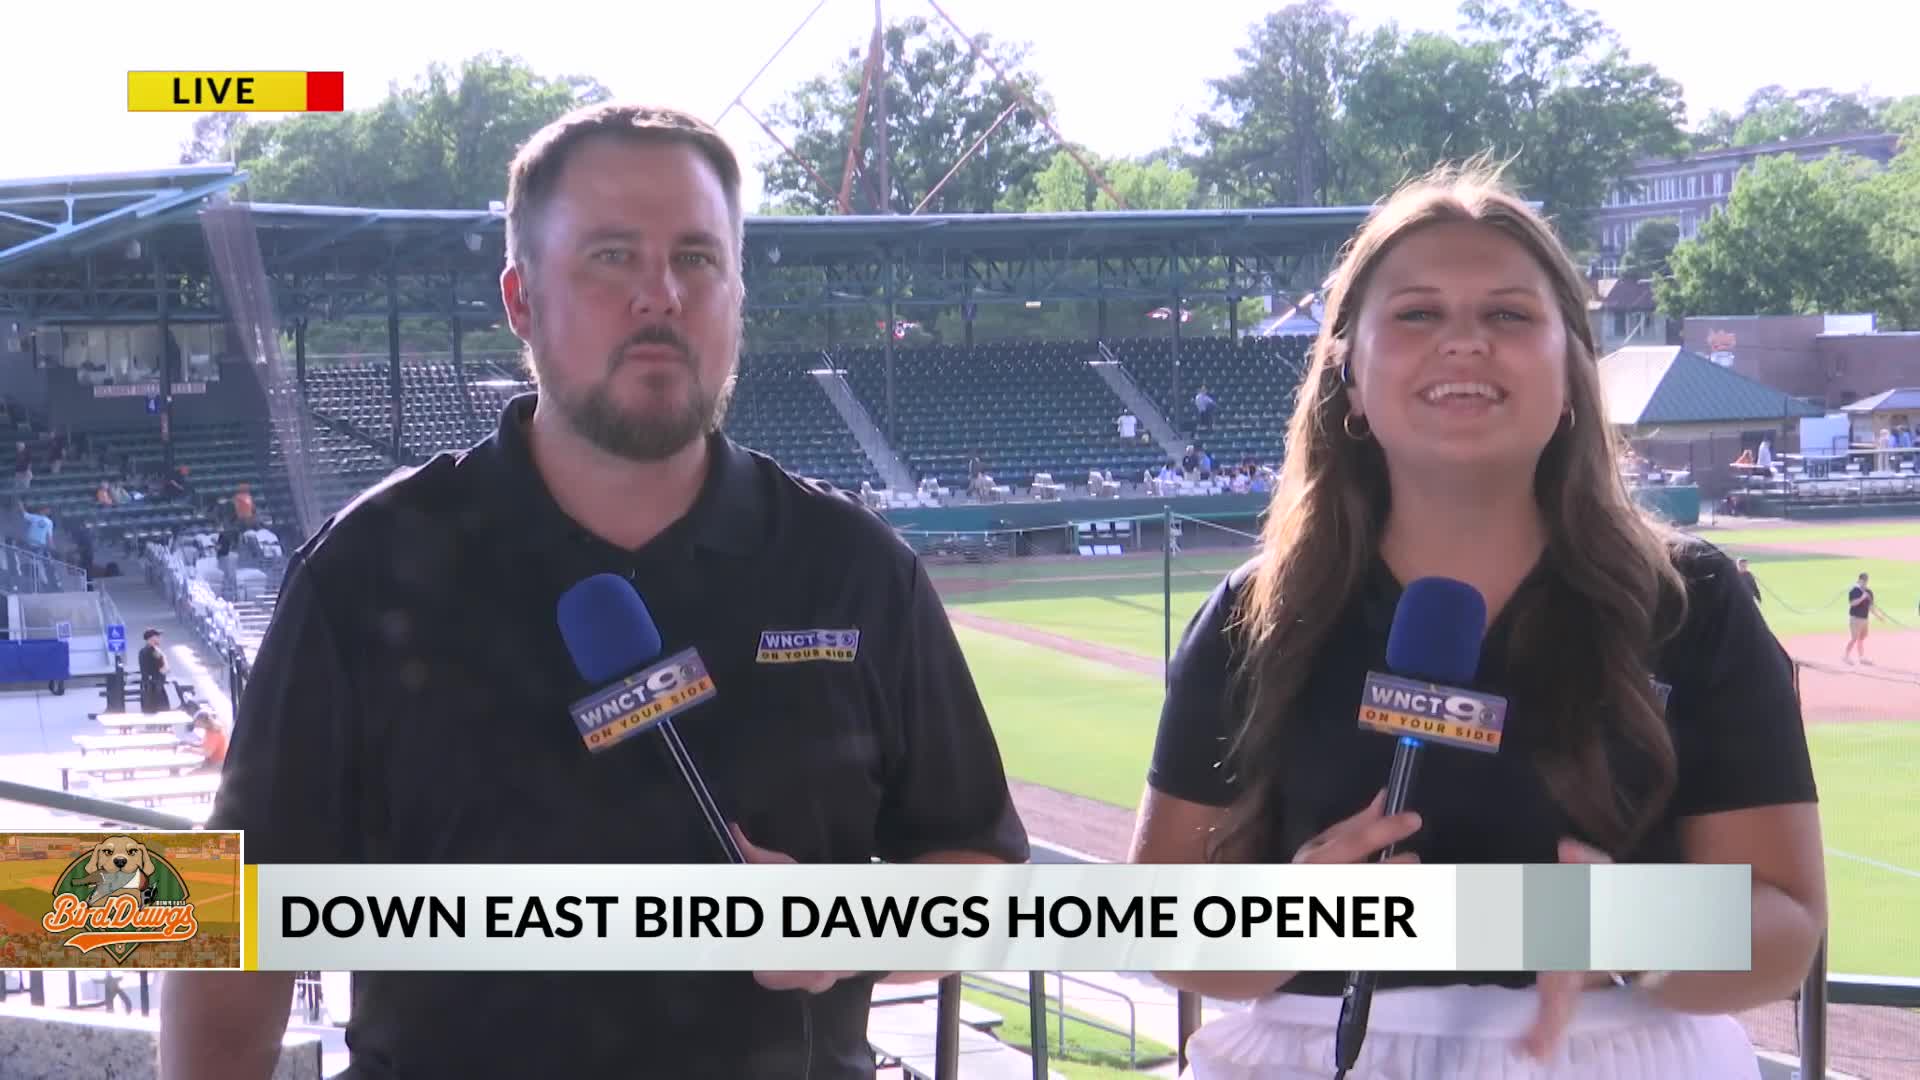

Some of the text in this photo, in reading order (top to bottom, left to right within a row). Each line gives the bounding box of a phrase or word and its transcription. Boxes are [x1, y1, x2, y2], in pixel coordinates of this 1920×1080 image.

[784, 648, 820, 659] YOUR
[589, 680, 709, 744] ON YOUR SIDE
[1365, 709, 1497, 743] ON YOUR SIDE
